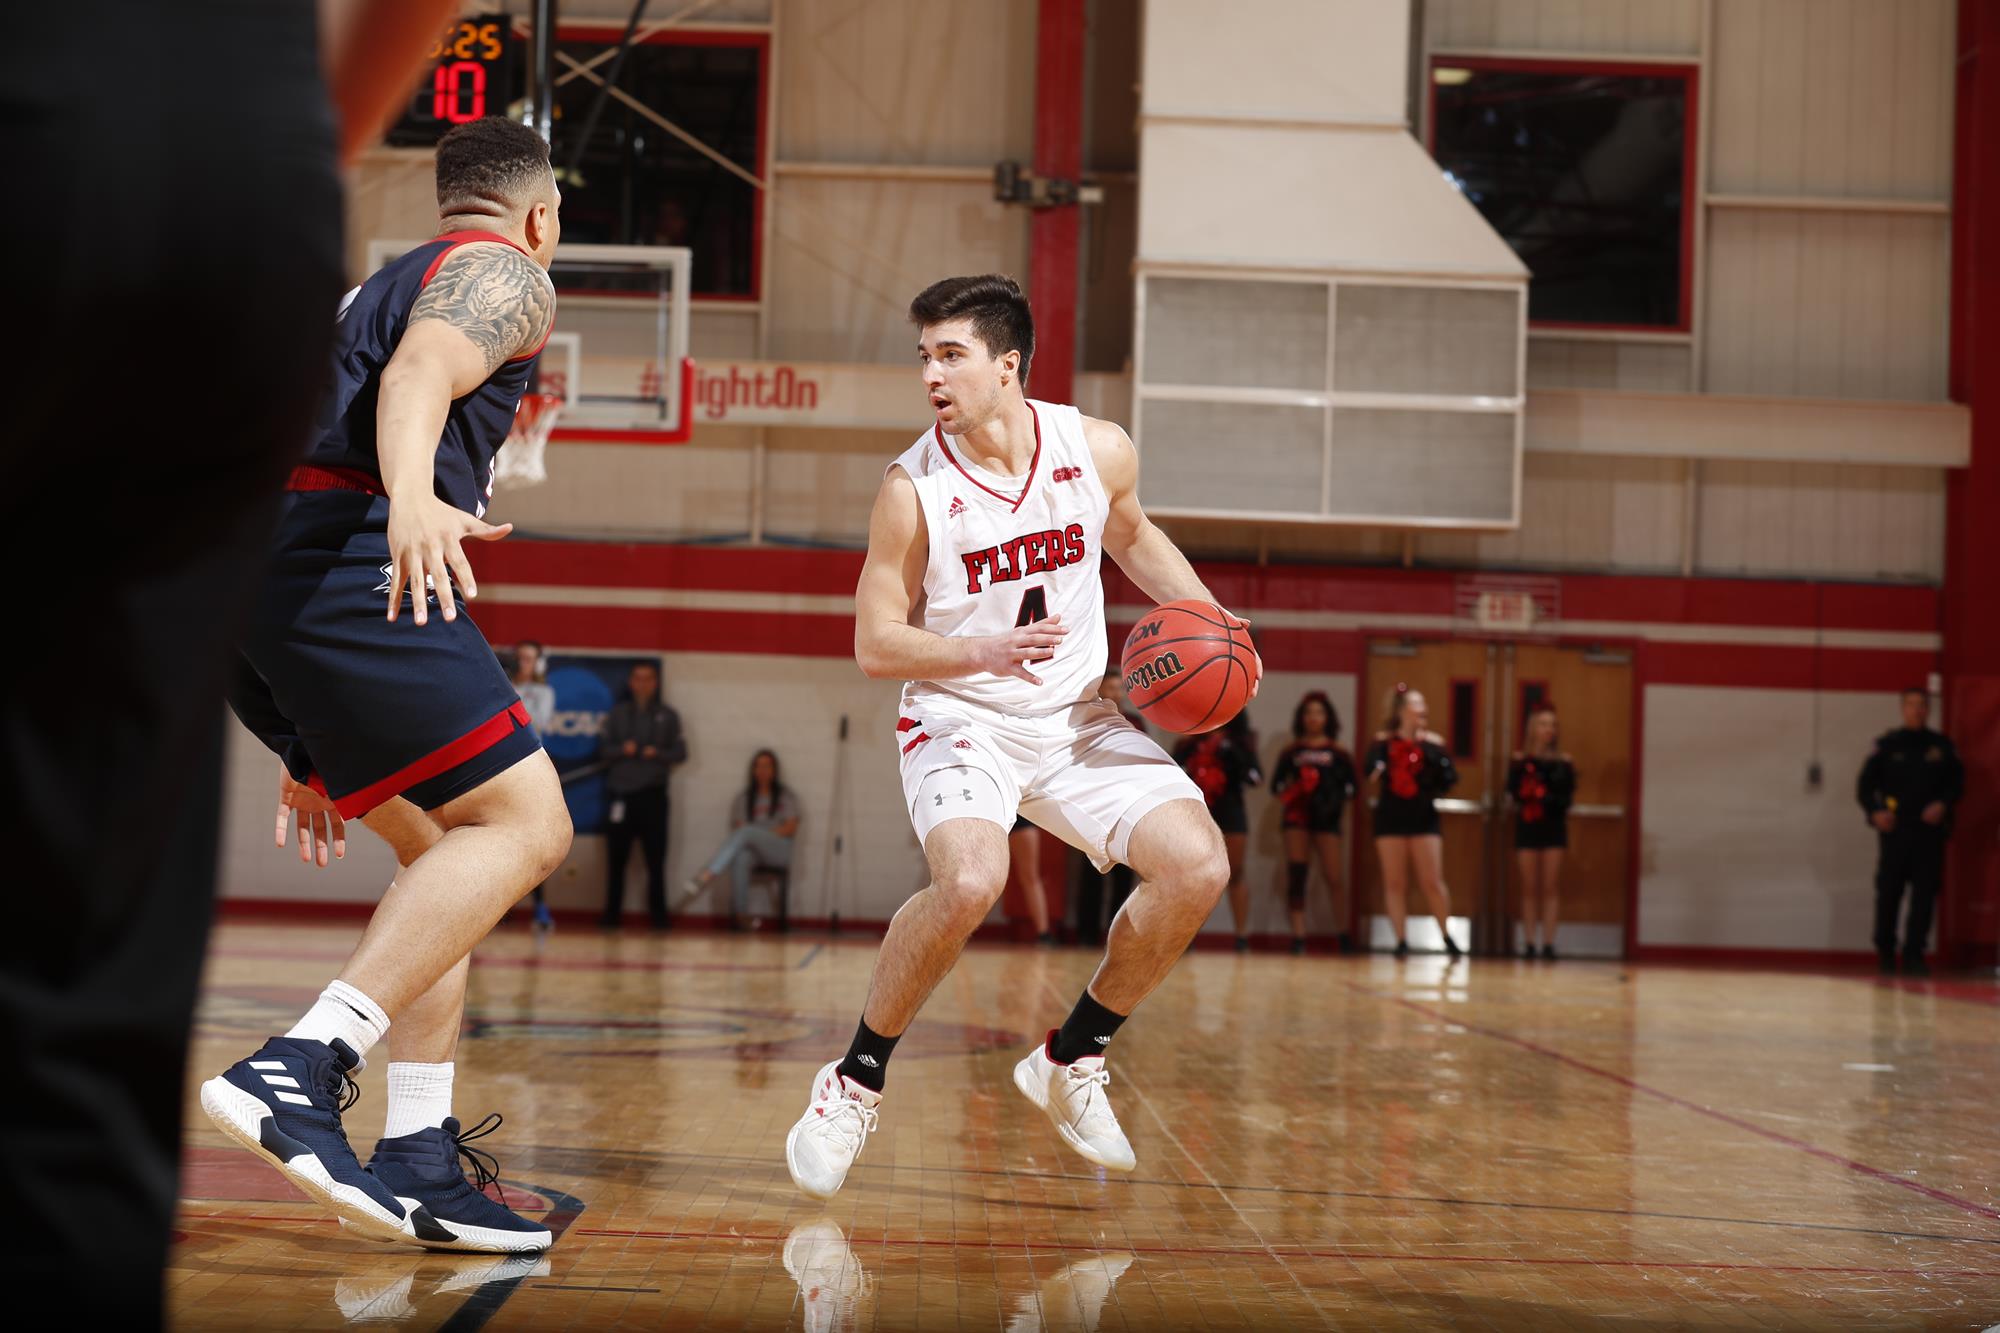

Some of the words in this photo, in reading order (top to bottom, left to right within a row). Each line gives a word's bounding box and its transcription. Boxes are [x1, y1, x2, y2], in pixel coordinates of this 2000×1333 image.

[433, 61, 487, 125] 10
[640, 360, 818, 419] #ightOn
[960, 522, 1085, 595] FLYERS
